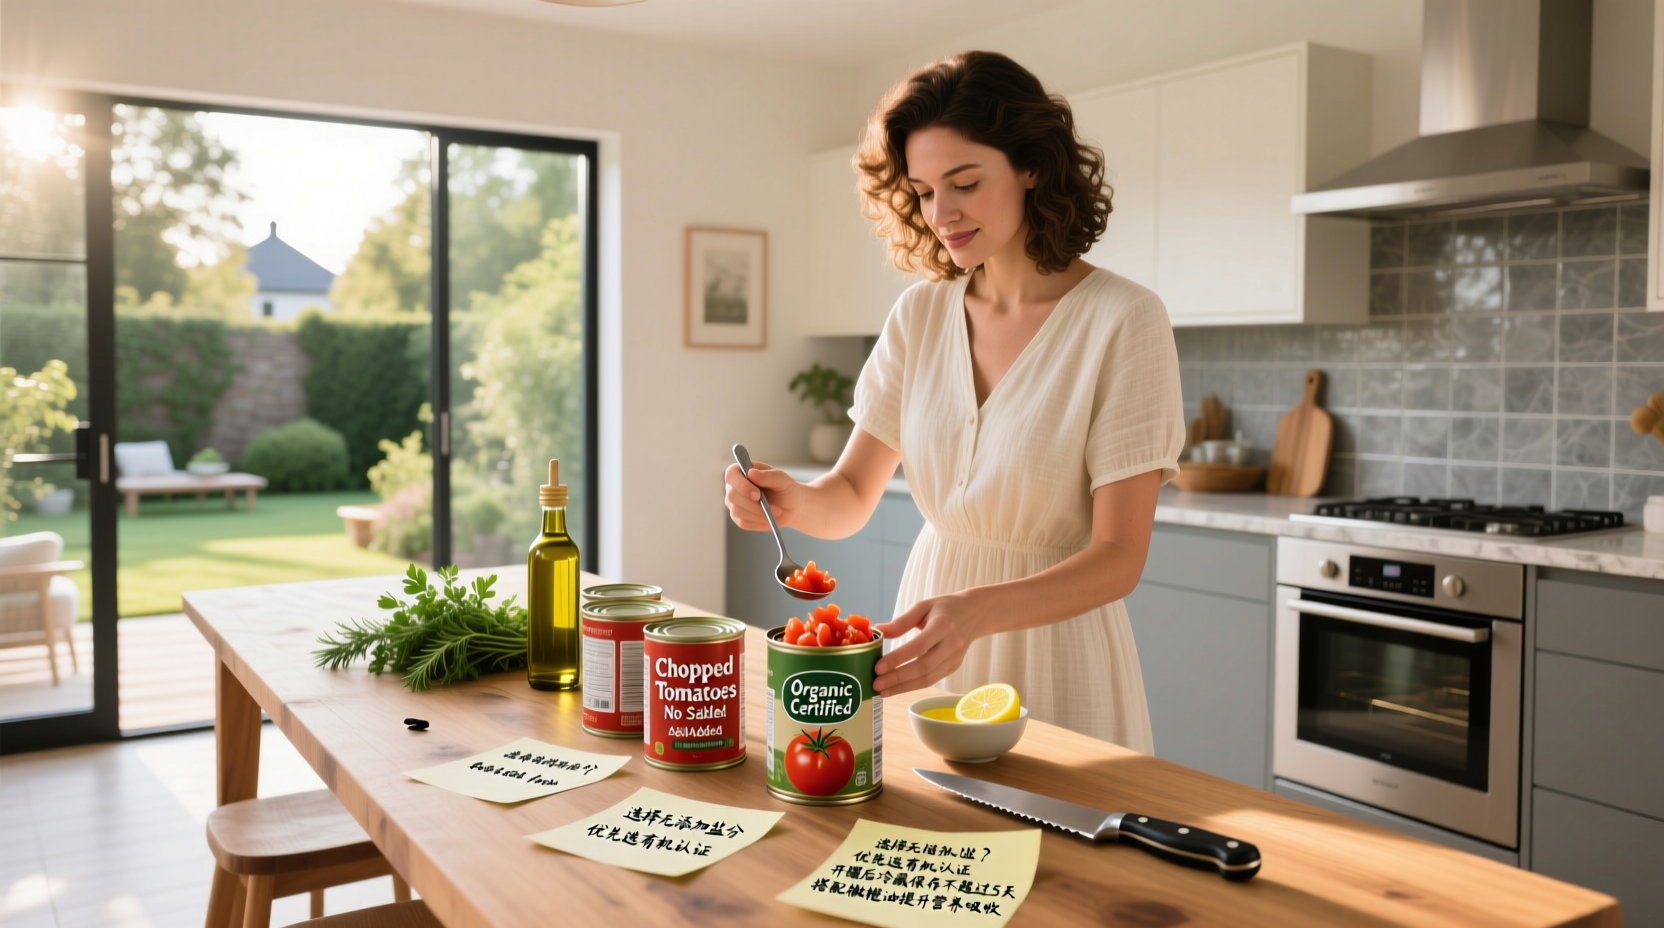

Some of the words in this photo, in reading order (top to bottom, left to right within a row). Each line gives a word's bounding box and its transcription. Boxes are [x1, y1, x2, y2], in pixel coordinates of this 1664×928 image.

[655, 655, 734, 684] Chopped
[655, 680, 737, 702] Tomatoes
[790, 678, 853, 703] Organic
[664, 705, 683, 720] No
